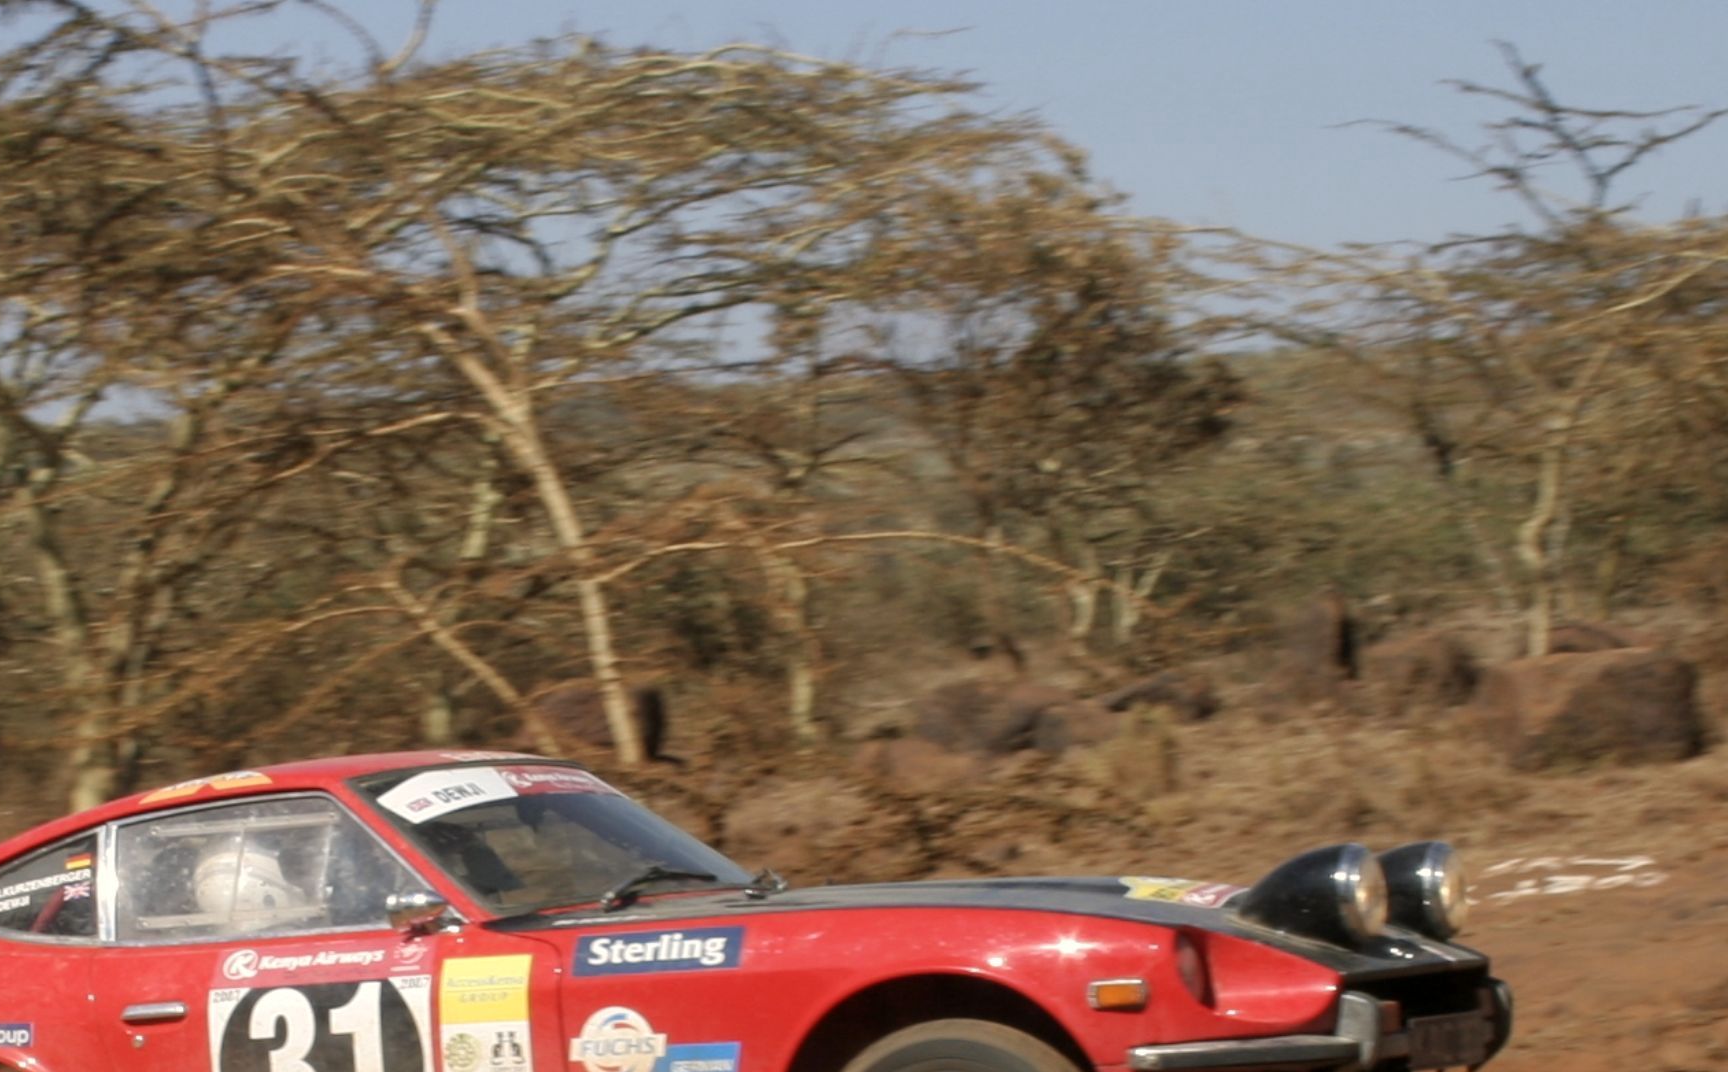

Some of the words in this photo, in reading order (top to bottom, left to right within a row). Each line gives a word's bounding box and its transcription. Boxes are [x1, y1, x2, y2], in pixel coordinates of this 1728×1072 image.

[431, 782, 487, 803] DEWJI
[258, 953, 312, 970] Kenya
[313, 949, 385, 966] Airways
[587, 933, 727, 965] Sterling
[581, 1037, 657, 1056] FUCHS
